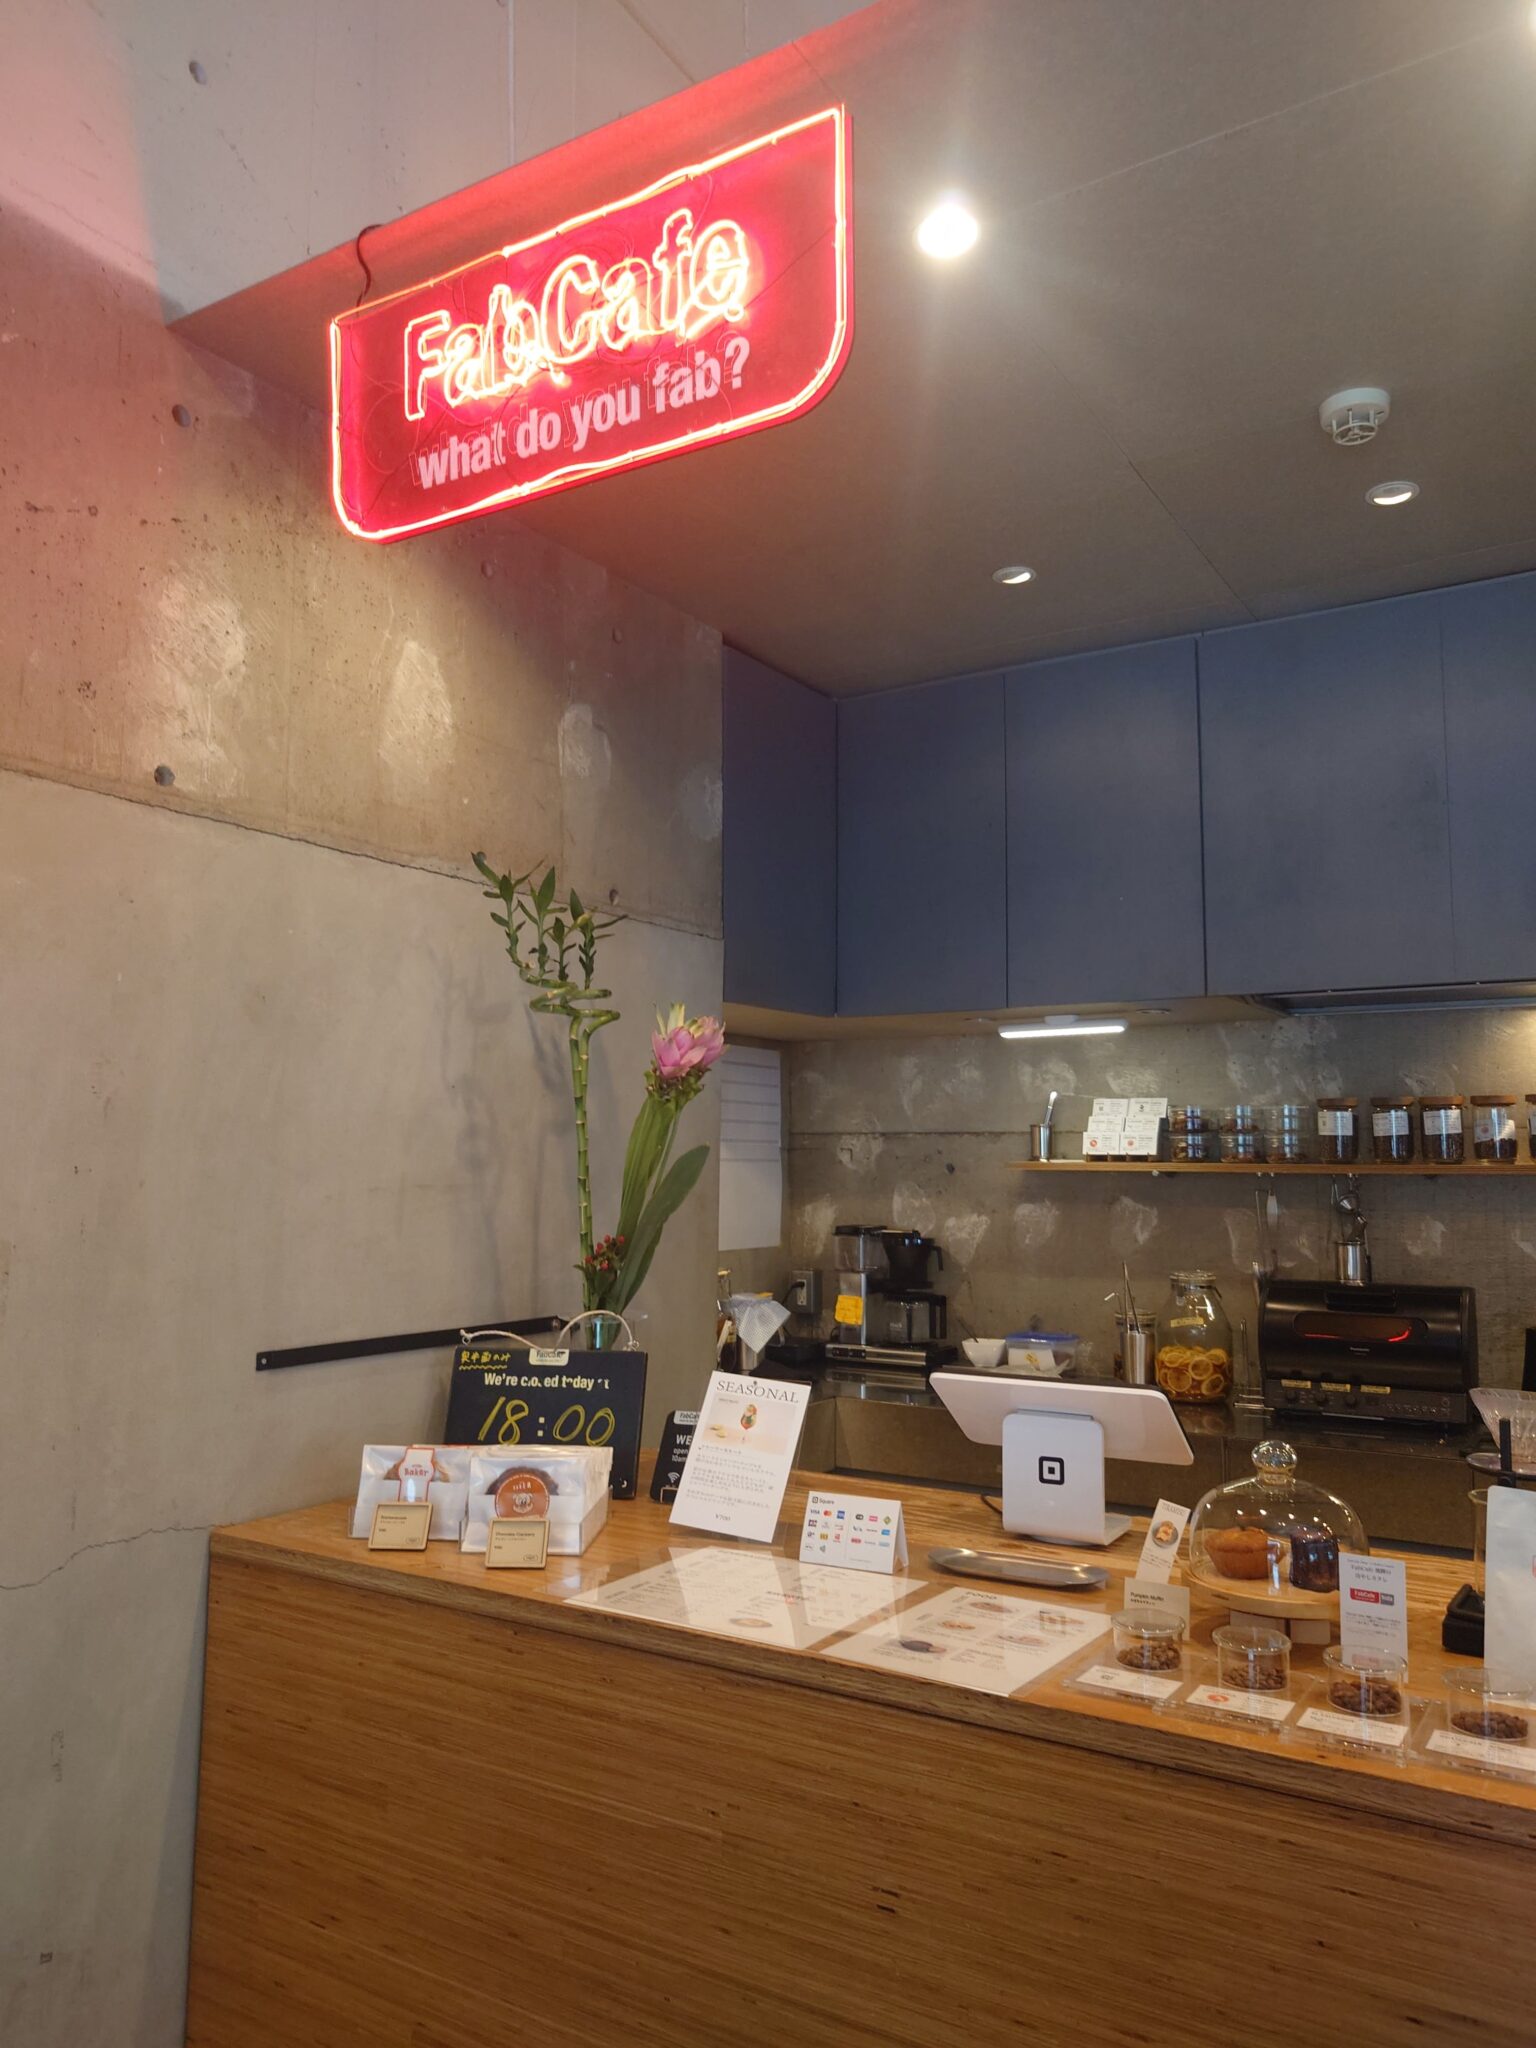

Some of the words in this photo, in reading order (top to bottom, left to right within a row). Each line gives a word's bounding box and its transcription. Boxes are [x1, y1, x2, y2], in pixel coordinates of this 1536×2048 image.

[404, 207, 752, 421] FabCafe
[417, 424, 507, 489] what
[516, 407, 562, 460] do
[571, 383, 641, 453] you
[652, 336, 751, 415] fab?
[484, 1373, 517, 1387] We're
[716, 1380, 799, 1403] SEASONAL
[477, 1396, 616, 1447] 18:00
